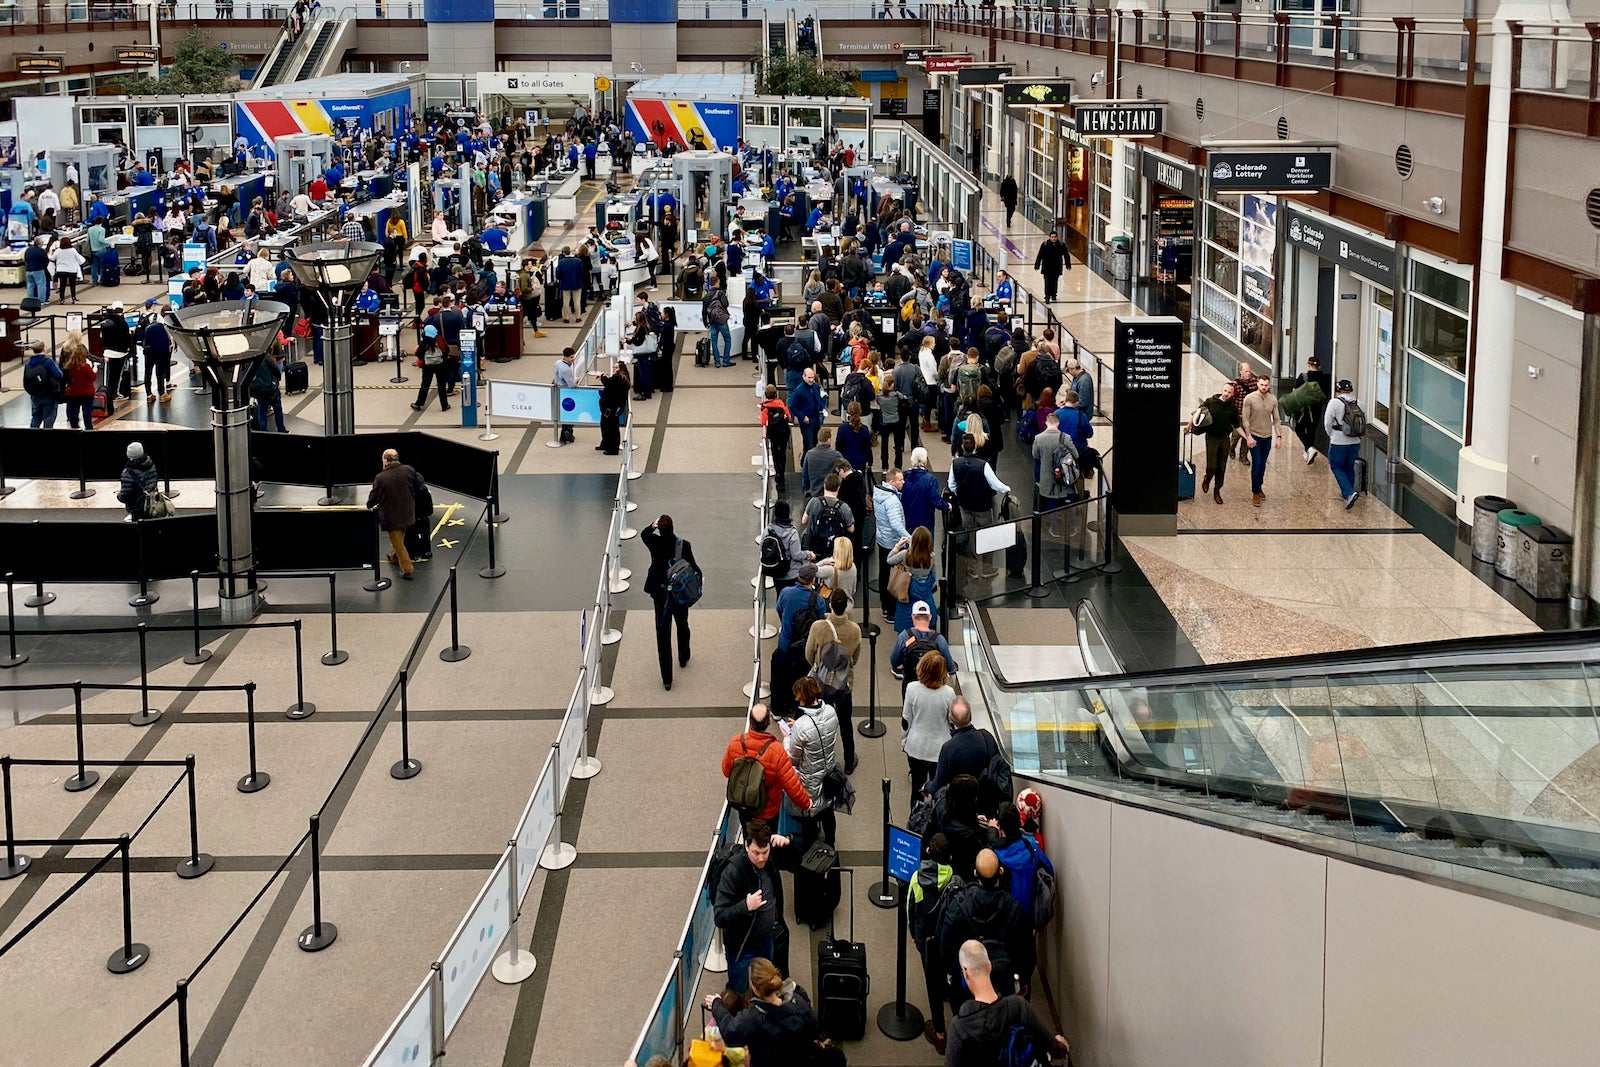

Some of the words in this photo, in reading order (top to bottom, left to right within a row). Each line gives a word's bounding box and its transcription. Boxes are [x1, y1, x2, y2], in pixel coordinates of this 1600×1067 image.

[230, 42, 261, 50] Terminal
[521, 80, 530, 88] to
[531, 79, 541, 88] all
[542, 80, 564, 88] Gates
[331, 104, 361, 112] Southwest
[704, 107, 730, 115] Southwest
[1083, 110, 1156, 132] NEWSSTAND
[1157, 161, 1183, 190] NEWSSTAND
[1235, 171, 1263, 179] Lottery
[1303, 224, 1324, 240] Colorado
[1303, 234, 1321, 250] Lottery
[1349, 250, 1360, 259] Denver
[1360, 256, 1378, 267] Workforce
[1377, 262, 1390, 272] Center
